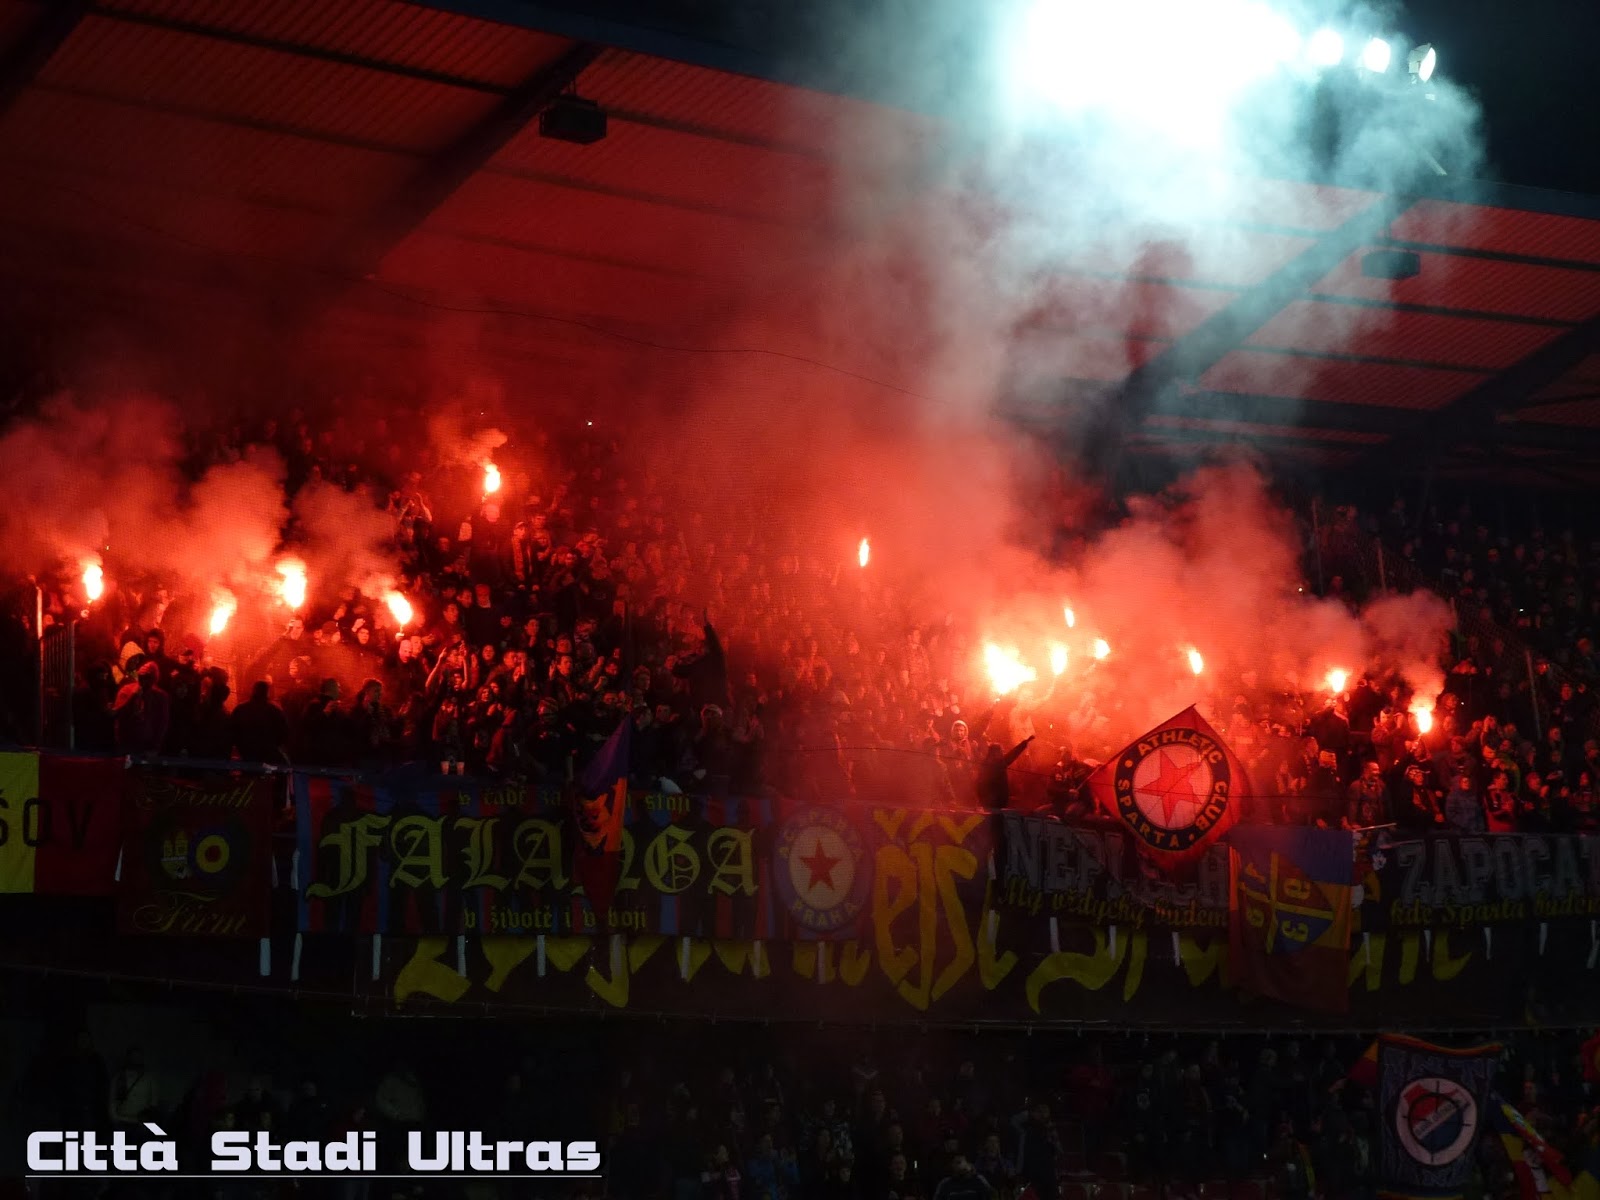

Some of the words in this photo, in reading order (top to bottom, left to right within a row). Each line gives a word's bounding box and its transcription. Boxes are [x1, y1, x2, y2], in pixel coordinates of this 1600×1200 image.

[1136, 730, 1223, 764] ATHLETIC
[1117, 778, 1180, 849] SPARTA
[1194, 780, 1229, 831] CLUB
